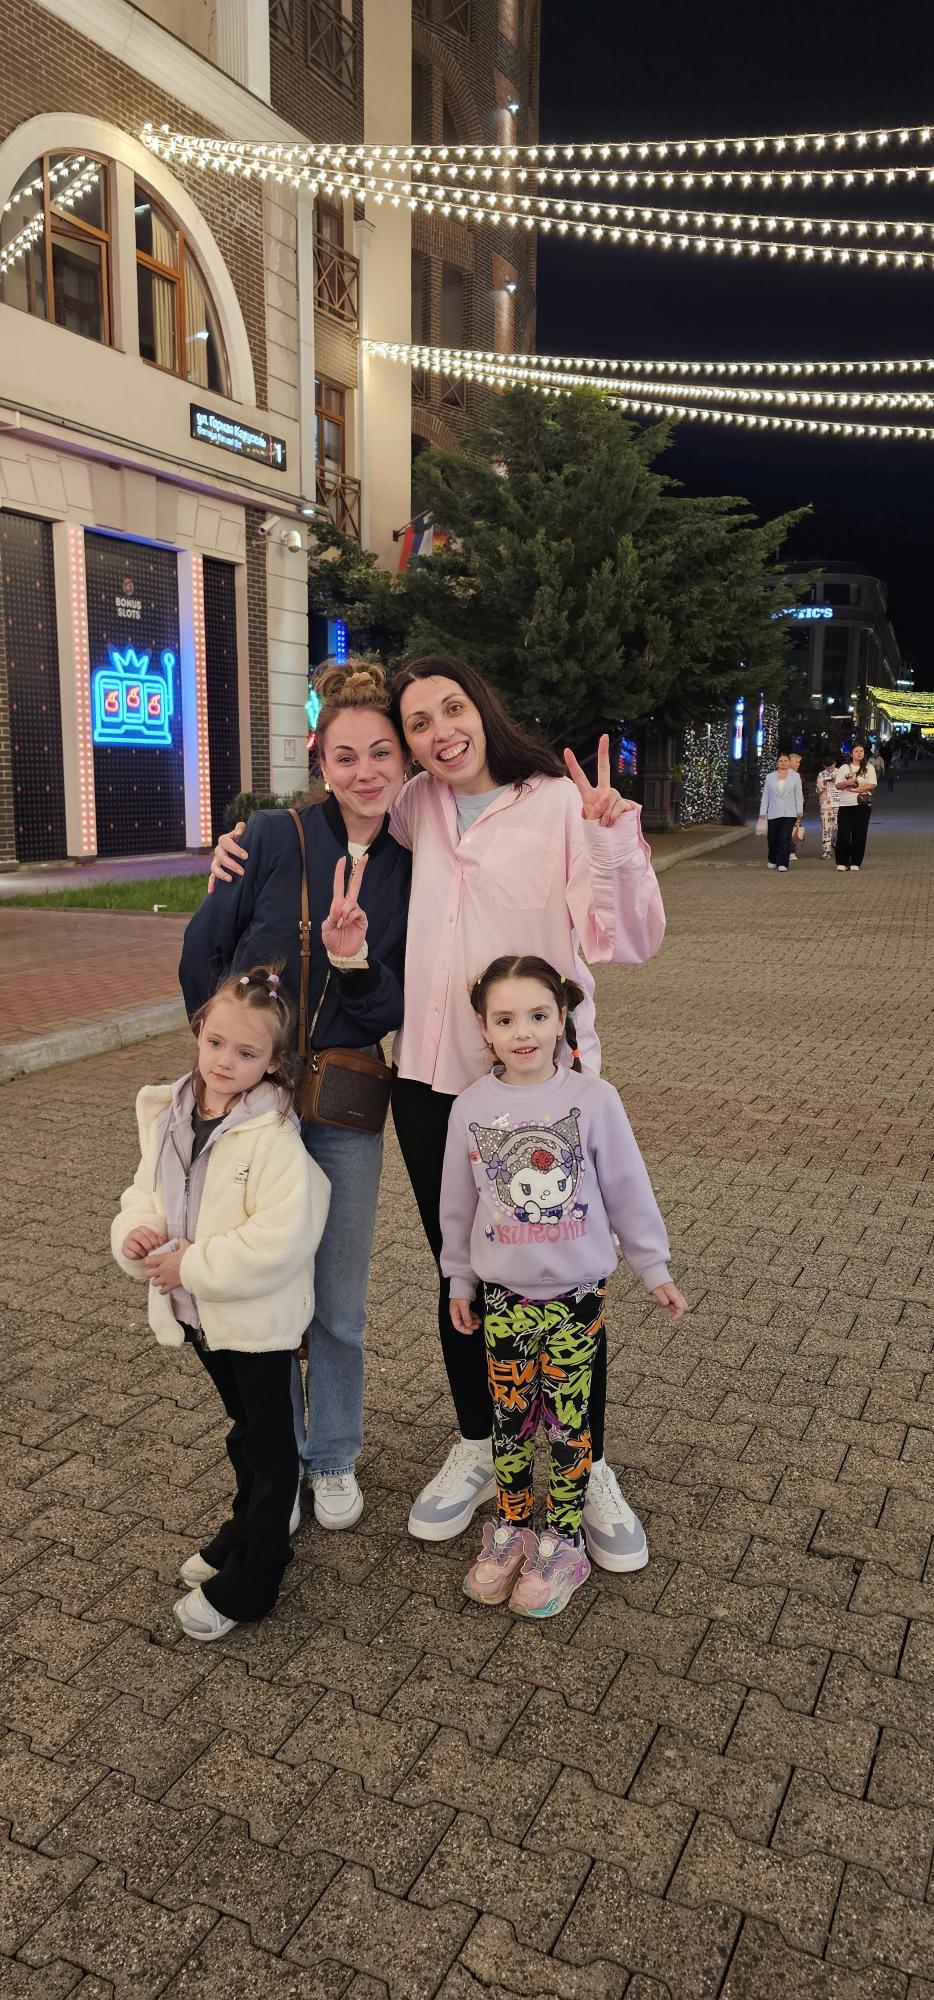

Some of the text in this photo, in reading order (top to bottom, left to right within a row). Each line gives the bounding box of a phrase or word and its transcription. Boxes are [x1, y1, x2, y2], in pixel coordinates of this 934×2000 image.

[196, 412, 267, 449] ул. Горная Карусель
[273, 442, 282, 463] 1
[115, 597, 142, 610] BONUS
[117, 607, 141, 620] SLOTS
[495, 1218, 588, 1245] KUROMI
